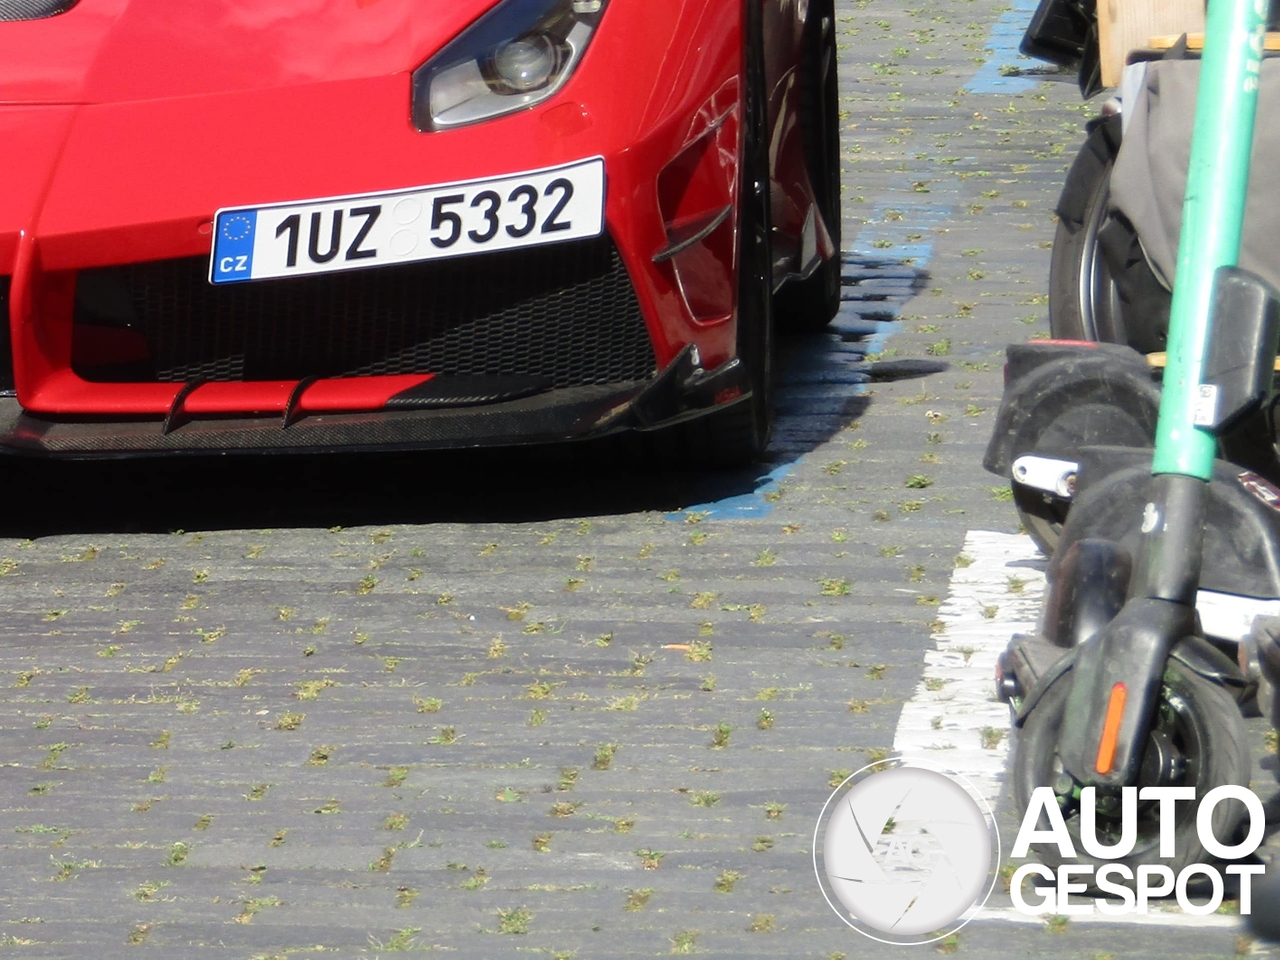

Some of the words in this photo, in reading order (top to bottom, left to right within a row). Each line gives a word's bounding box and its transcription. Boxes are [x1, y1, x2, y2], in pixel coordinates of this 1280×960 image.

[275, 204, 382, 268] 1UZ
[430, 177, 575, 249] 5332
[219, 254, 248, 274] CZ
